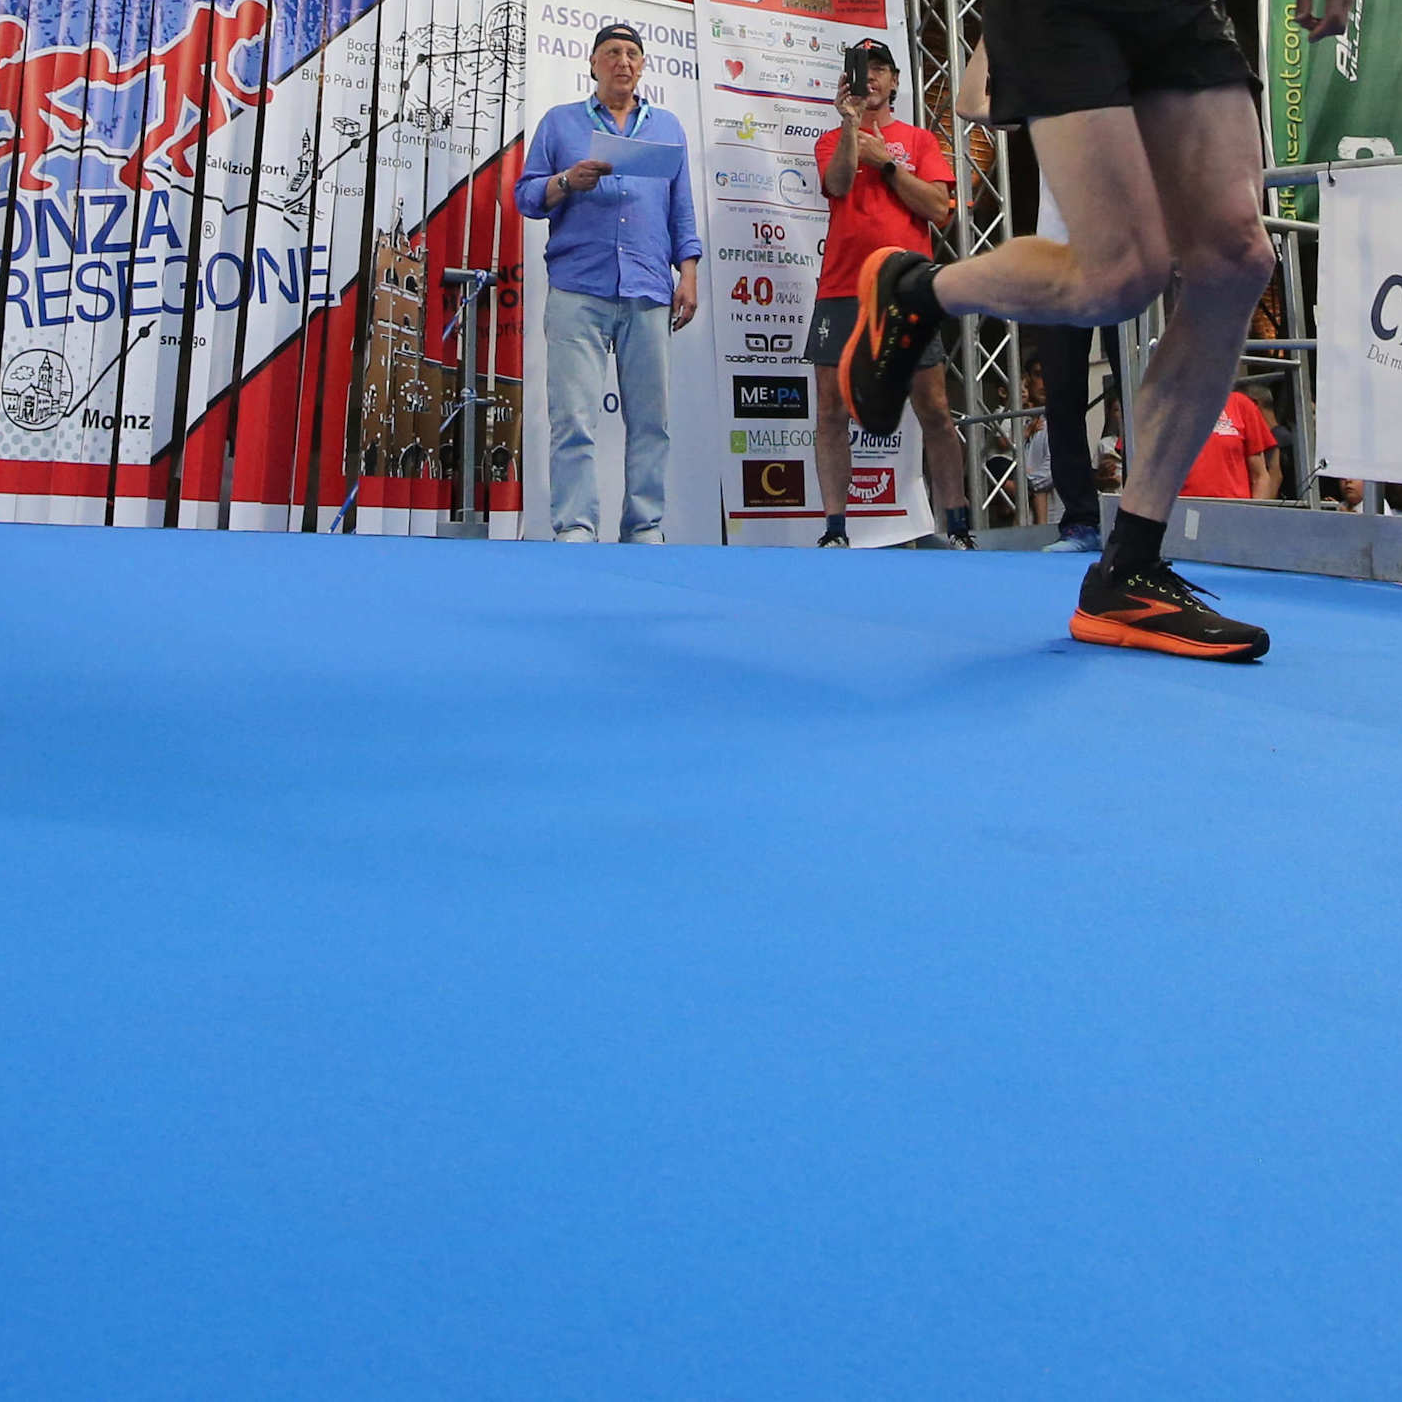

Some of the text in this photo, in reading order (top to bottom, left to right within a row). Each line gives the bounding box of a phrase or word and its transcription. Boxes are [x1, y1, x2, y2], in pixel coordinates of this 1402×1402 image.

[540, 4, 696, 50] ASSOCZIONE
[538, 34, 699, 80] RADIATORI
[301, 68, 332, 84] Bivo
[333, 72, 354, 88] Prà
[355, 74, 369, 89] di
[576, 73, 665, 105] ITANI
[392, 131, 448, 150] Controllo
[358, 153, 413, 171] Lvatoio
[794, 158, 818, 168] Spons
[321, 180, 364, 198] Chiesa
[752, 222, 786, 244] 100
[718, 248, 775, 264] OFFICINE
[778, 251, 815, 268] LOCATI
[730, 275, 774, 307] 40
[730, 313, 805, 325] INCARTARE
[1366, 343, 1389, 365] Dai
[860, 430, 903, 449] Ravasi
